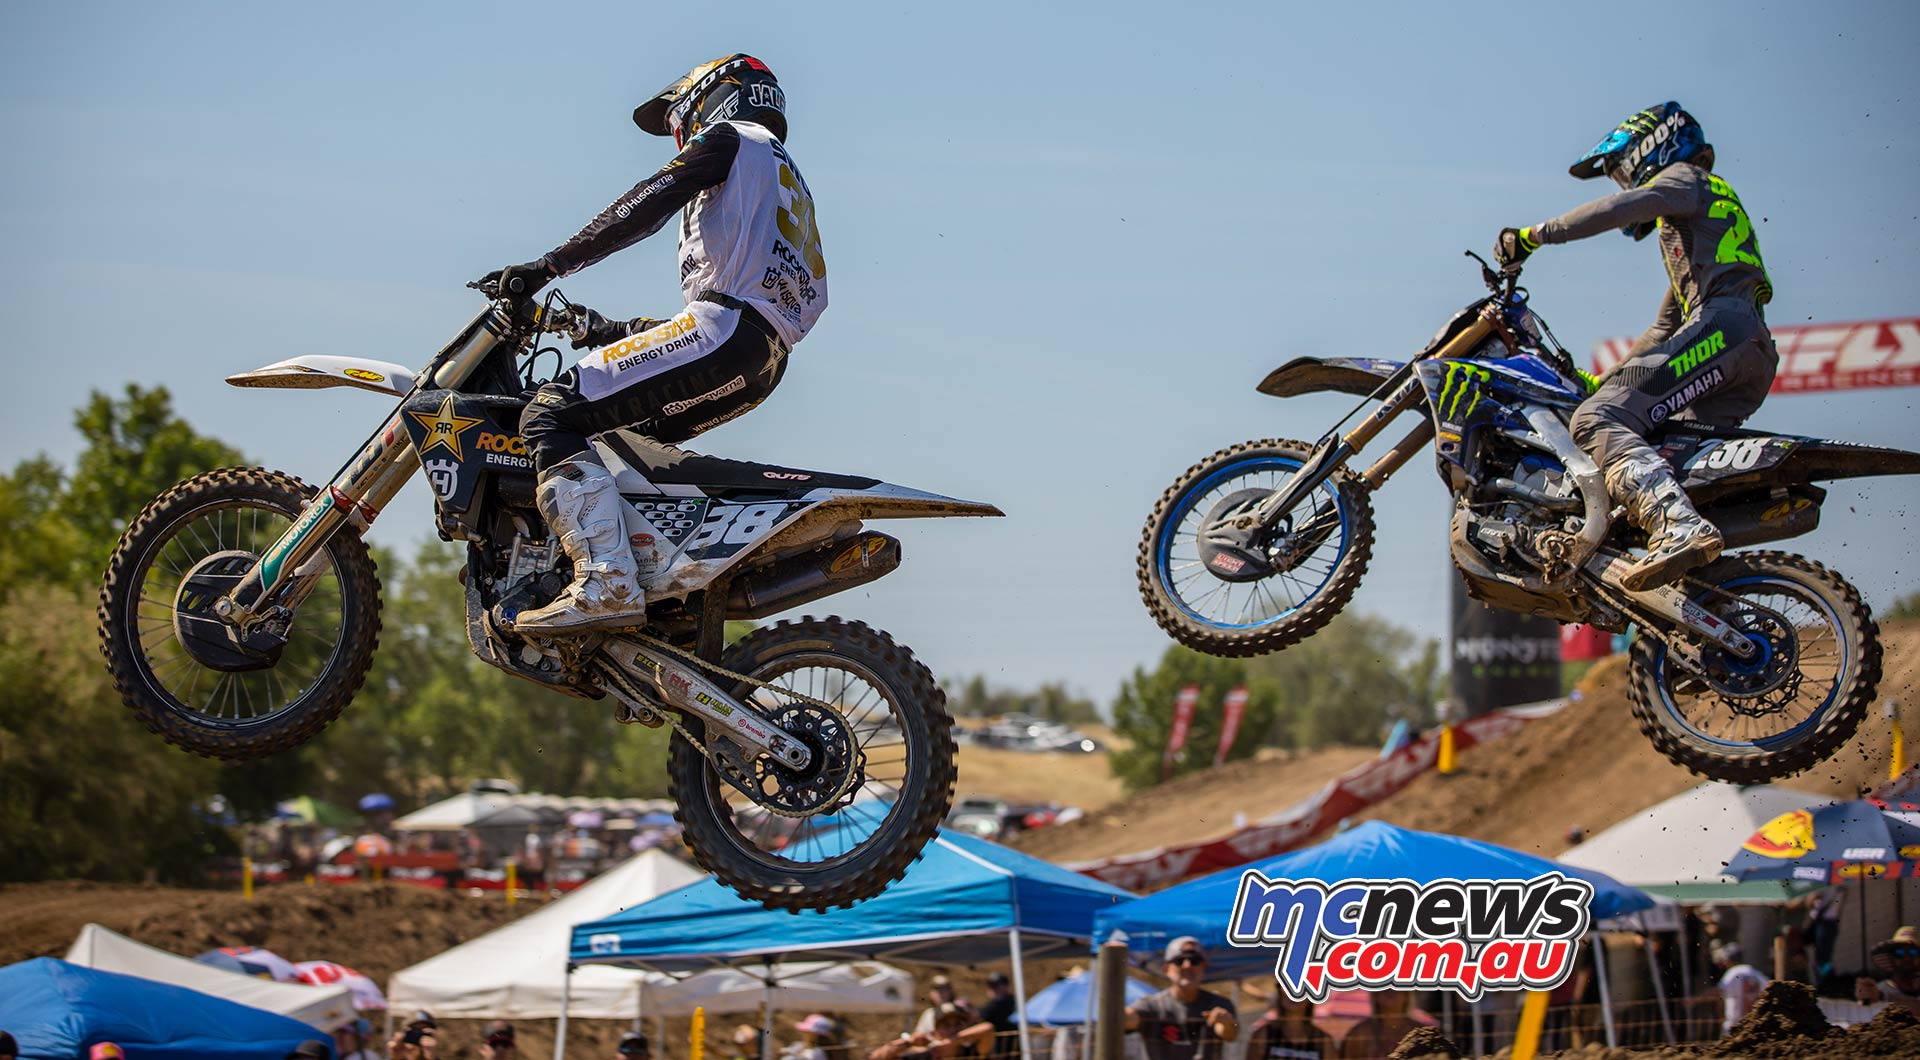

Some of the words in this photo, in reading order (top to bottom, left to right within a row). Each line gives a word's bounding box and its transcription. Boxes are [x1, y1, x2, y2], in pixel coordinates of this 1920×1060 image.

[680, 58, 745, 118] SCOTT
[1629, 111, 1686, 167] 100%
[627, 174, 674, 210] Husqvarna
[603, 311, 697, 364] ROCKSTAR
[617, 346, 664, 371] ENERGY
[665, 330, 702, 353] DRINK
[1668, 330, 1726, 377] THOR
[1666, 369, 1723, 411] YAMAHA
[1683, 422, 1716, 431] YAMAHA
[486, 453, 534, 468] ENERGY
[281, 498, 330, 549] MOTOREX
[687, 503, 788, 551] 38
[745, 723, 766, 739] brembo
